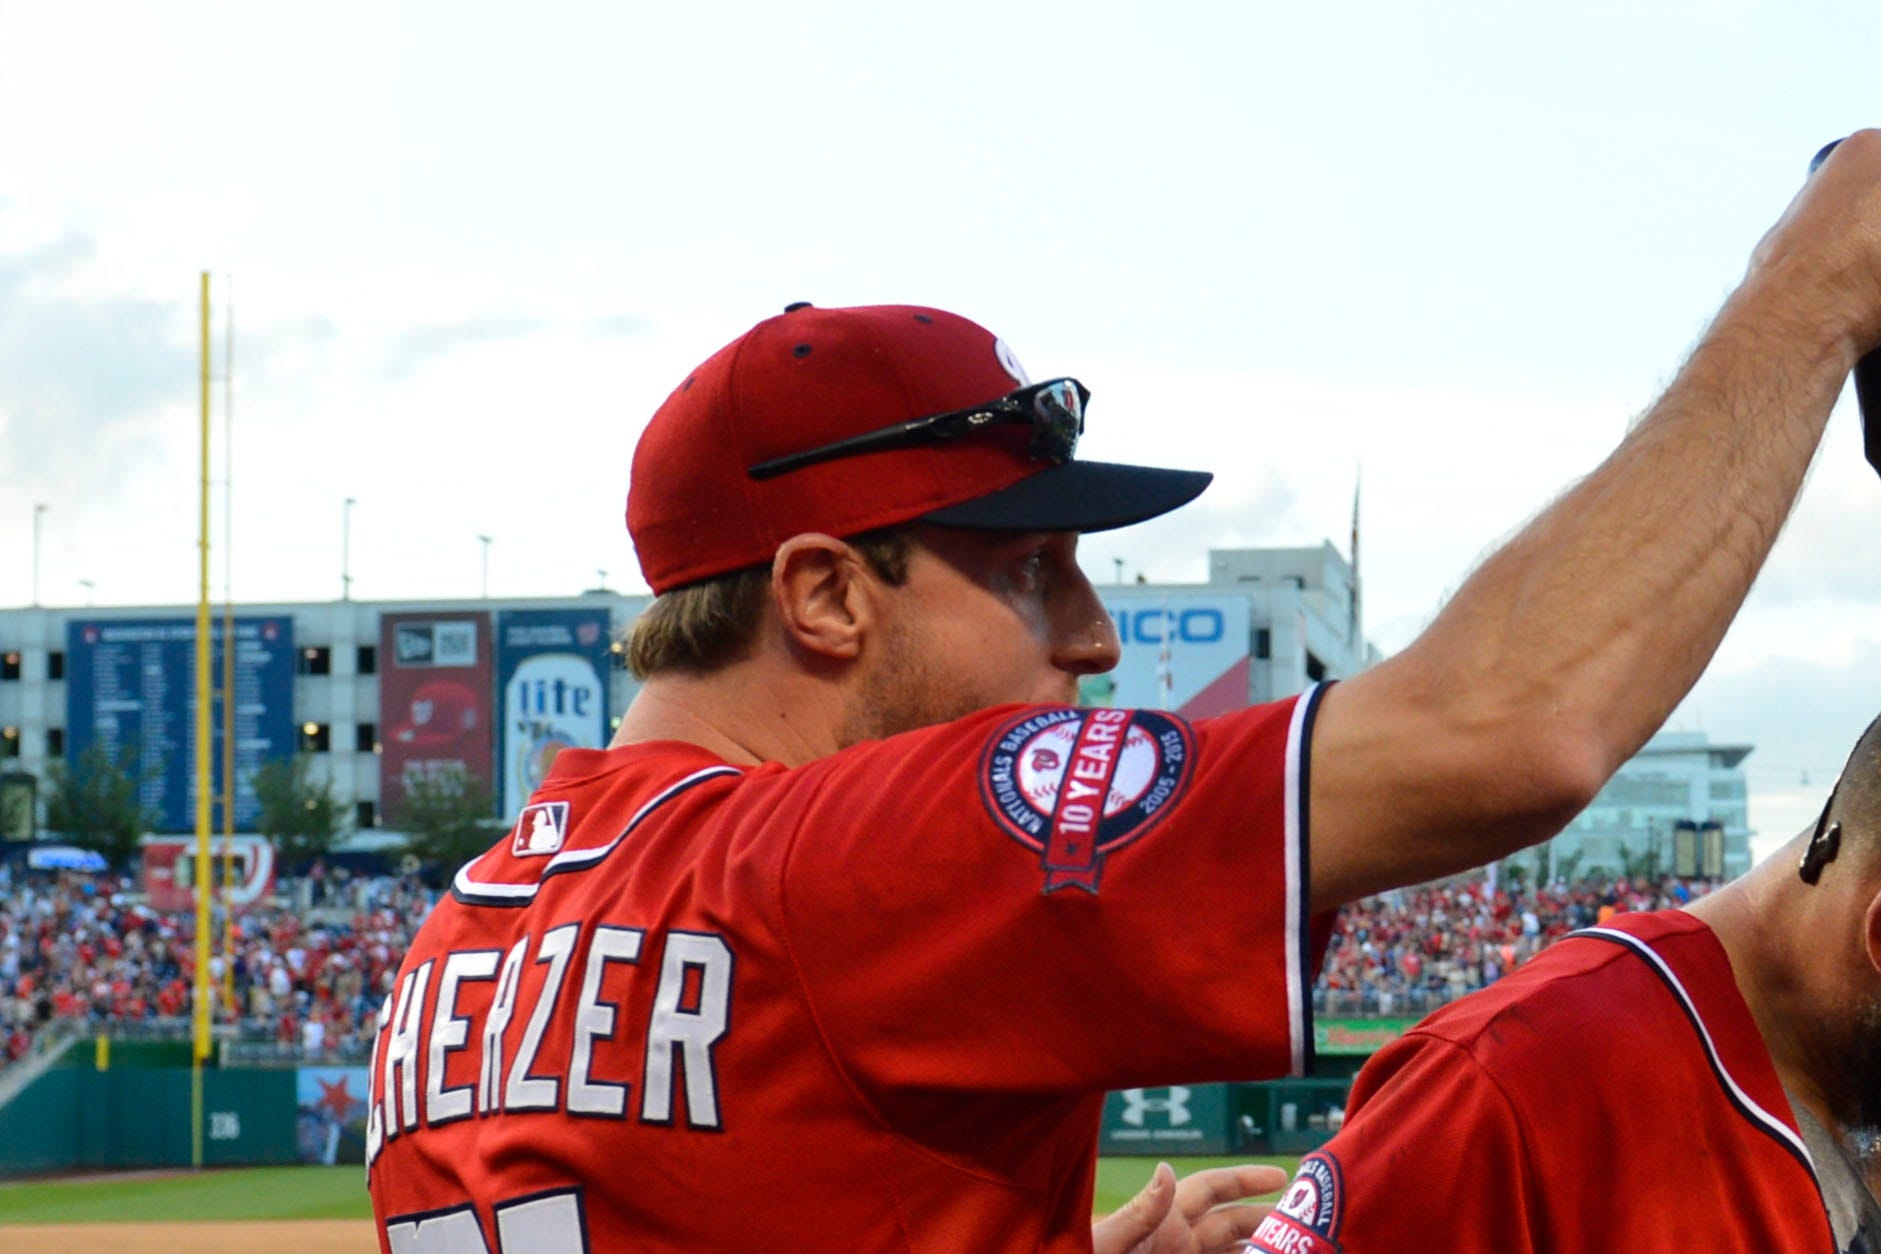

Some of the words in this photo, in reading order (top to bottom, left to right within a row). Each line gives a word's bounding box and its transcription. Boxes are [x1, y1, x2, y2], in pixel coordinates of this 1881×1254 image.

[1110, 609, 1224, 643] ICO
[519, 678, 590, 717] lite
[1000, 710, 1079, 752] BASEBALL
[1066, 710, 1126, 800] YEARS
[992, 755, 1044, 834] NATIONALS
[1140, 776, 1175, 815] 2005
[1160, 730, 1183, 762] 2015
[1059, 804, 1095, 834] 10
[366, 921, 736, 1172] CHERZER
